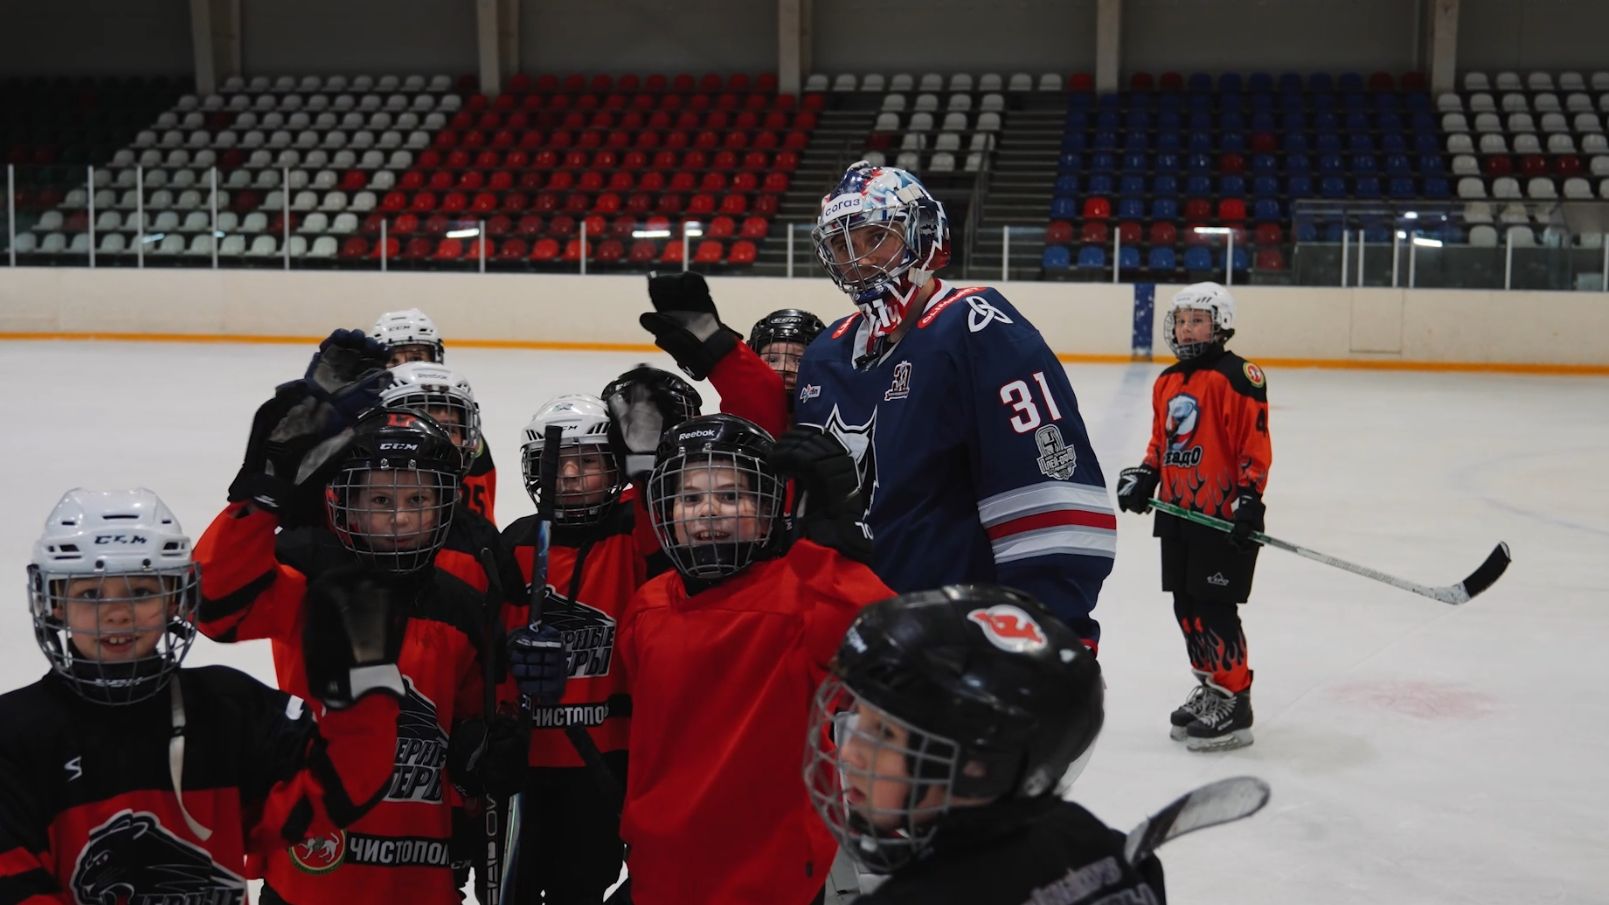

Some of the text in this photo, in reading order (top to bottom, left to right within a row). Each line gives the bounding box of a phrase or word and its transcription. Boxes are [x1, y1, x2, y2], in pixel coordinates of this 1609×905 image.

[998, 370, 1063, 435] 31
[678, 427, 716, 441] Reebok
[379, 442, 419, 451] CCM
[94, 534, 148, 545] CCM
